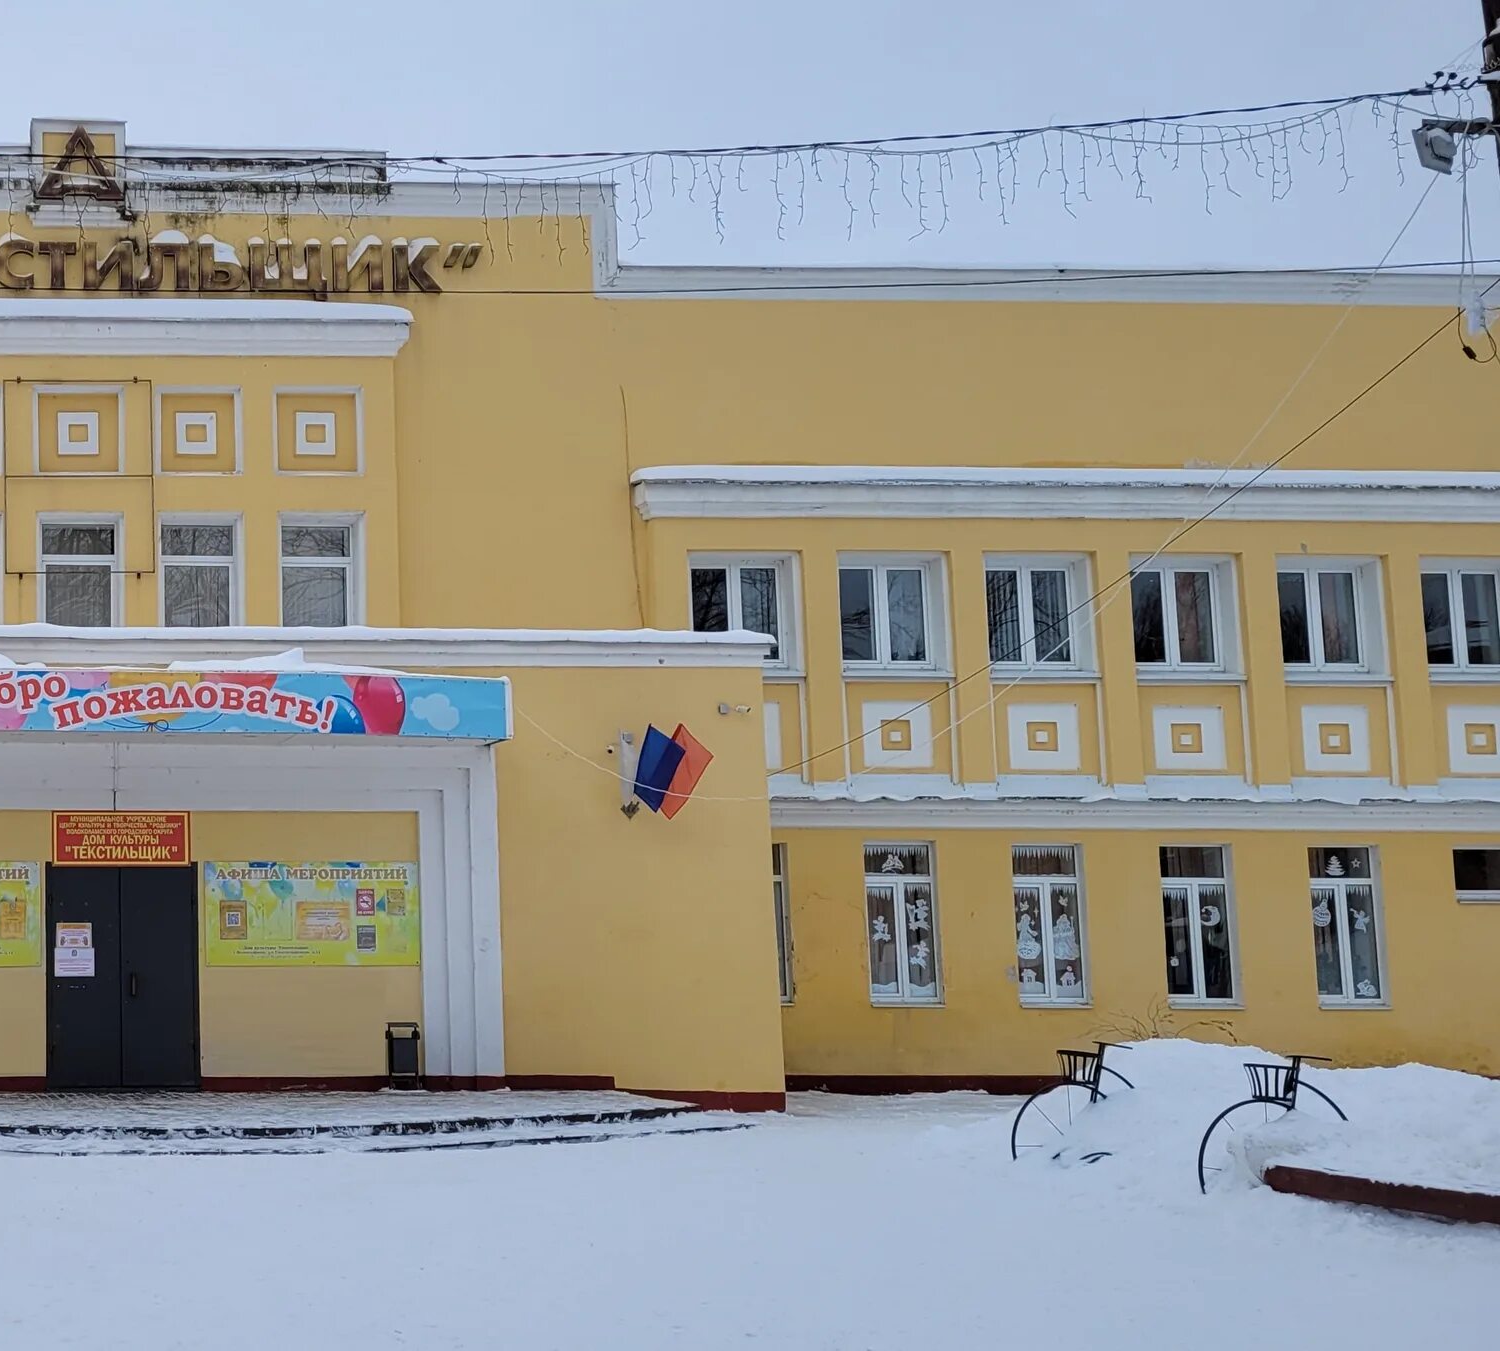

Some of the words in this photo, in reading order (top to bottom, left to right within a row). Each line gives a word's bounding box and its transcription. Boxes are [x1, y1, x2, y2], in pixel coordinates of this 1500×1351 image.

[53, 685, 334, 730] пожаловать!
[82, 835, 105, 846] ДОМ
[110, 835, 159, 845] КУЛЬТУРЫ
[65, 846, 178, 861] "ТЕКСТИЛЬЩИК"
[216, 868, 278, 880] АФИША
[286, 866, 408, 880] МЕРОПРИЯТИЙ
